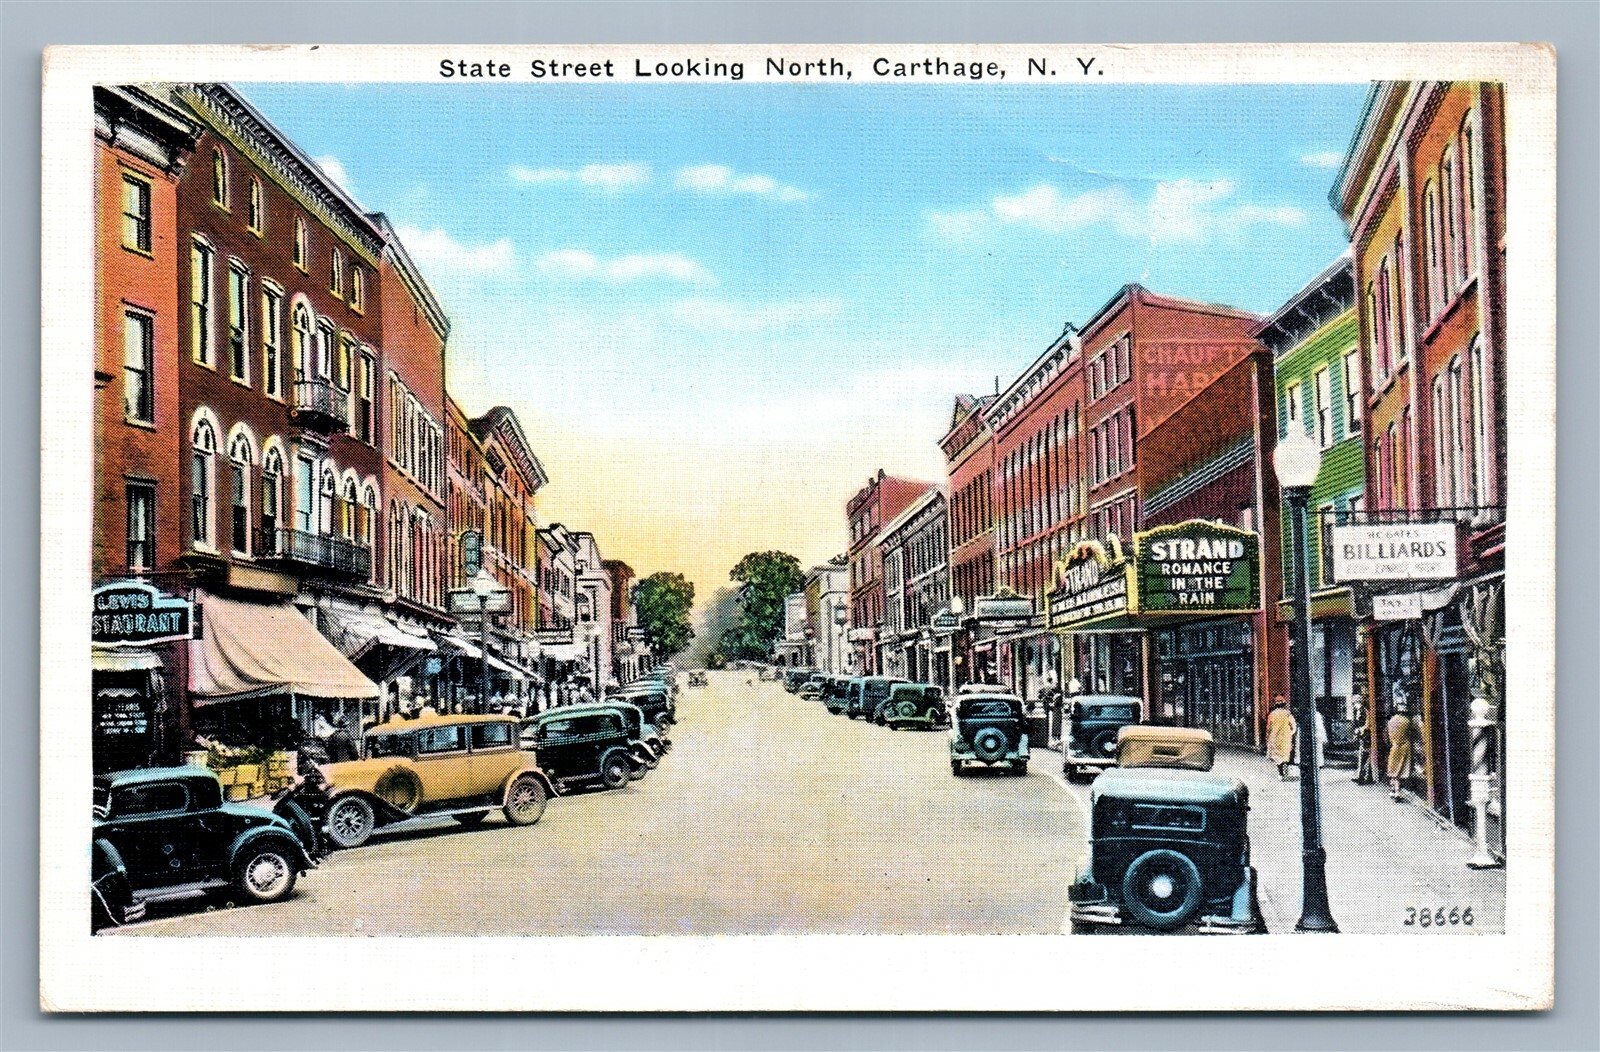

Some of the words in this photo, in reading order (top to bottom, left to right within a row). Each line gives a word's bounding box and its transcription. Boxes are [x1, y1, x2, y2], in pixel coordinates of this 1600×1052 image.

[440, 60, 510, 77] State
[531, 60, 613, 77] Street
[636, 58, 743, 80] Looking
[767, 58, 851, 79] North,
[874, 58, 1005, 79] Carthage,
[1029, 59, 1055, 75] N.
[1077, 58, 1103, 75] Y.
[1151, 538, 1245, 560] STRAND
[1343, 540, 1448, 560] BILLIARDS
[1161, 562, 1232, 575] ROMANCE
[1171, 576, 1187, 590] IN
[1195, 576, 1224, 589] THE
[1178, 592, 1215, 605] RAIN
[1403, 905, 1475, 929] 38666
